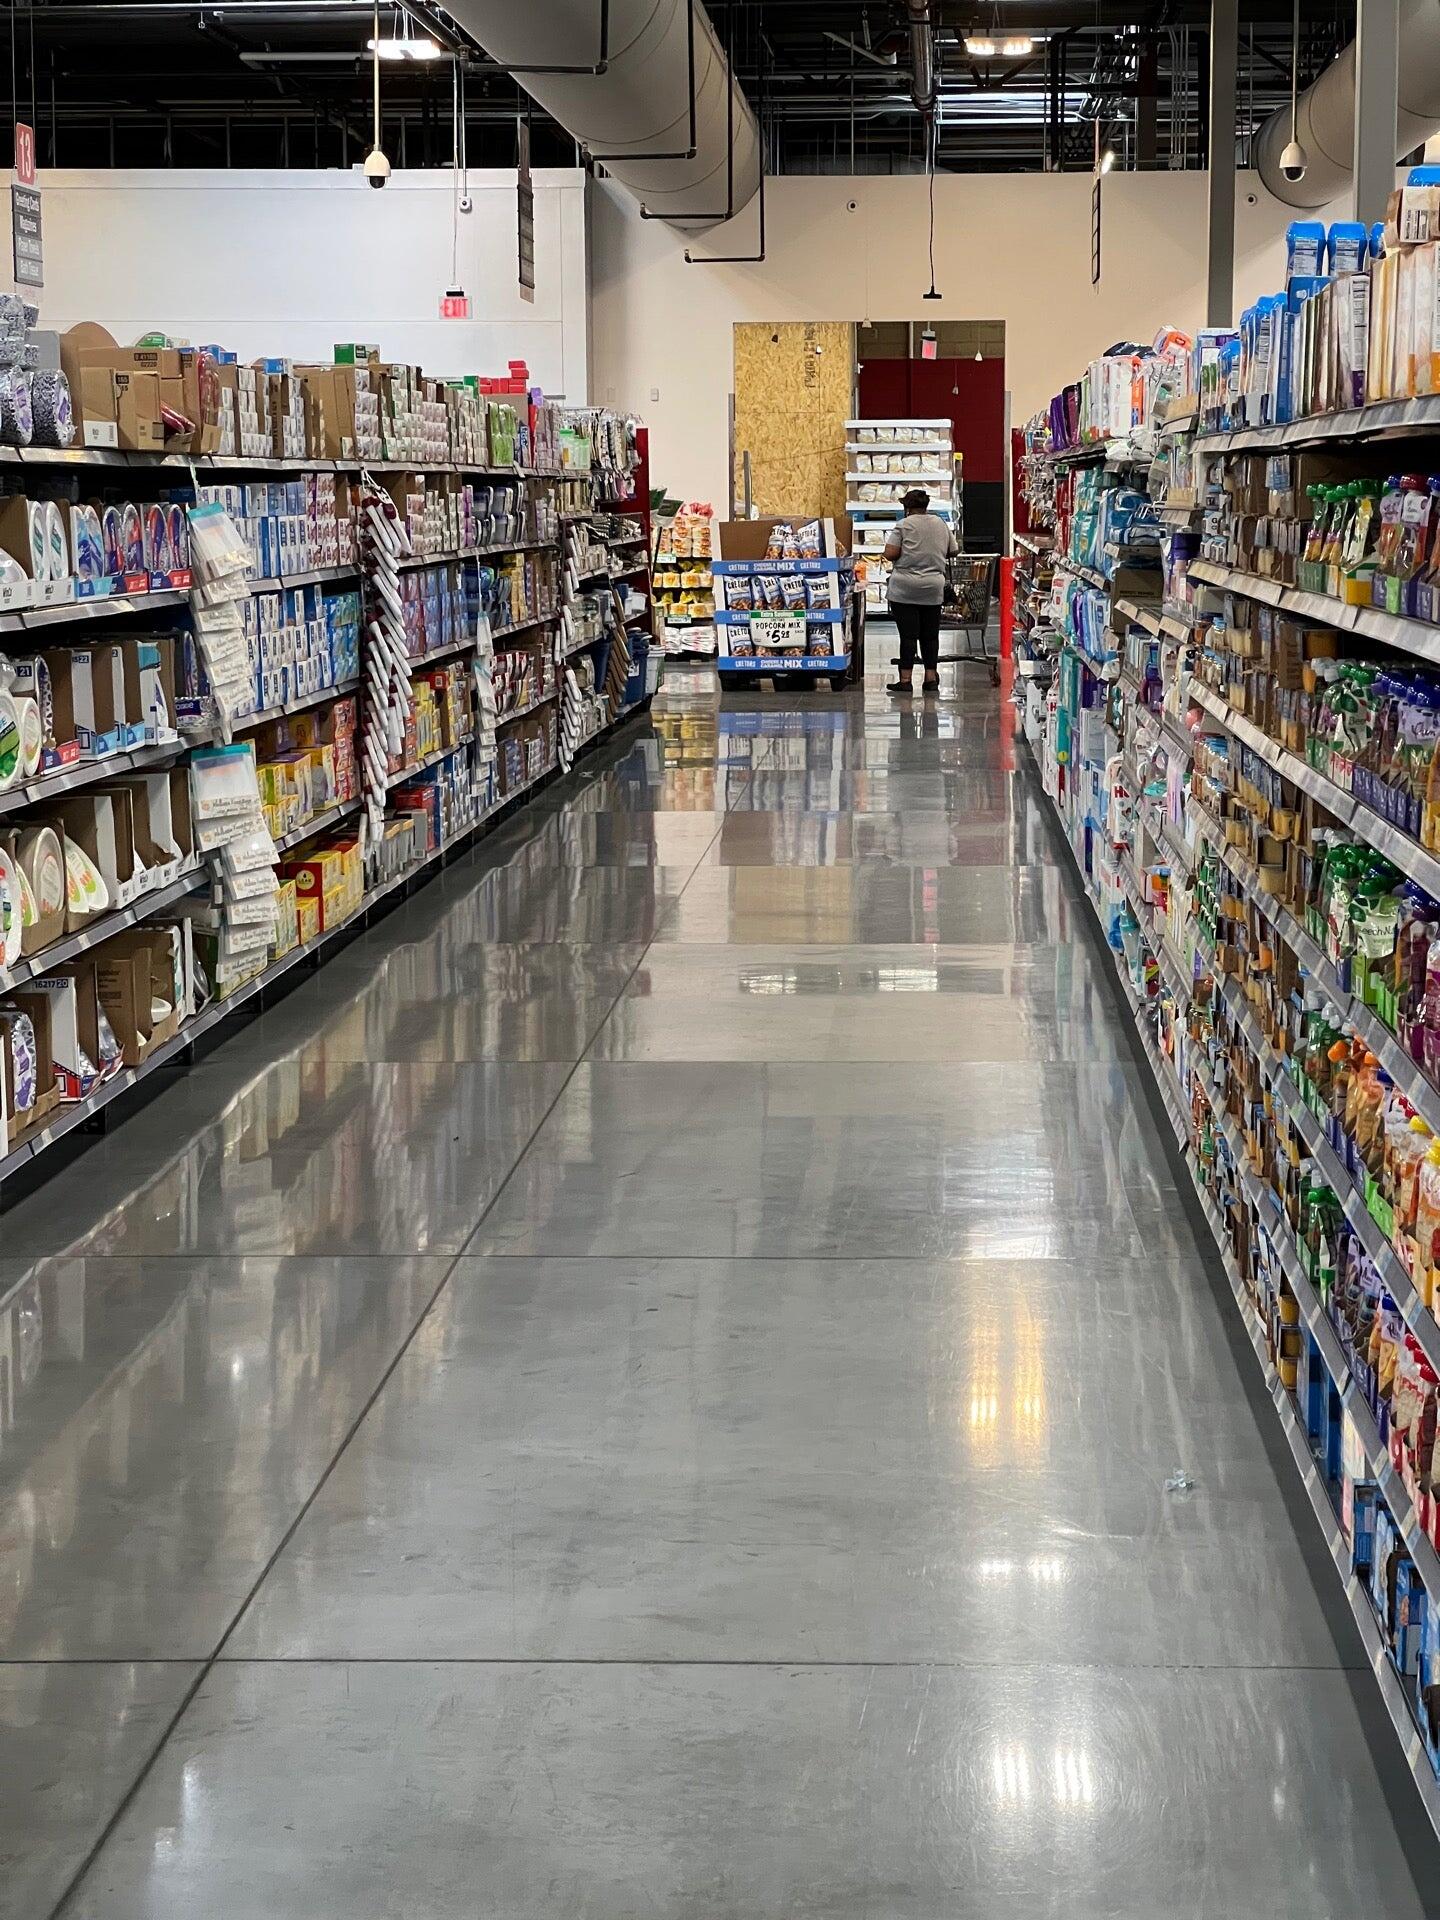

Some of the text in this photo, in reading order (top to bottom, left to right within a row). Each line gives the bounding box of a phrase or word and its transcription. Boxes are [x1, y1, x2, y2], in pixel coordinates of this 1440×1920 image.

[20, 131, 32, 178] 13
[444, 298, 468, 317] EXIT
[776, 562, 795, 571] MIX
[755, 621, 801, 630] POPCORN MIX
[784, 659, 803, 668] MIX
